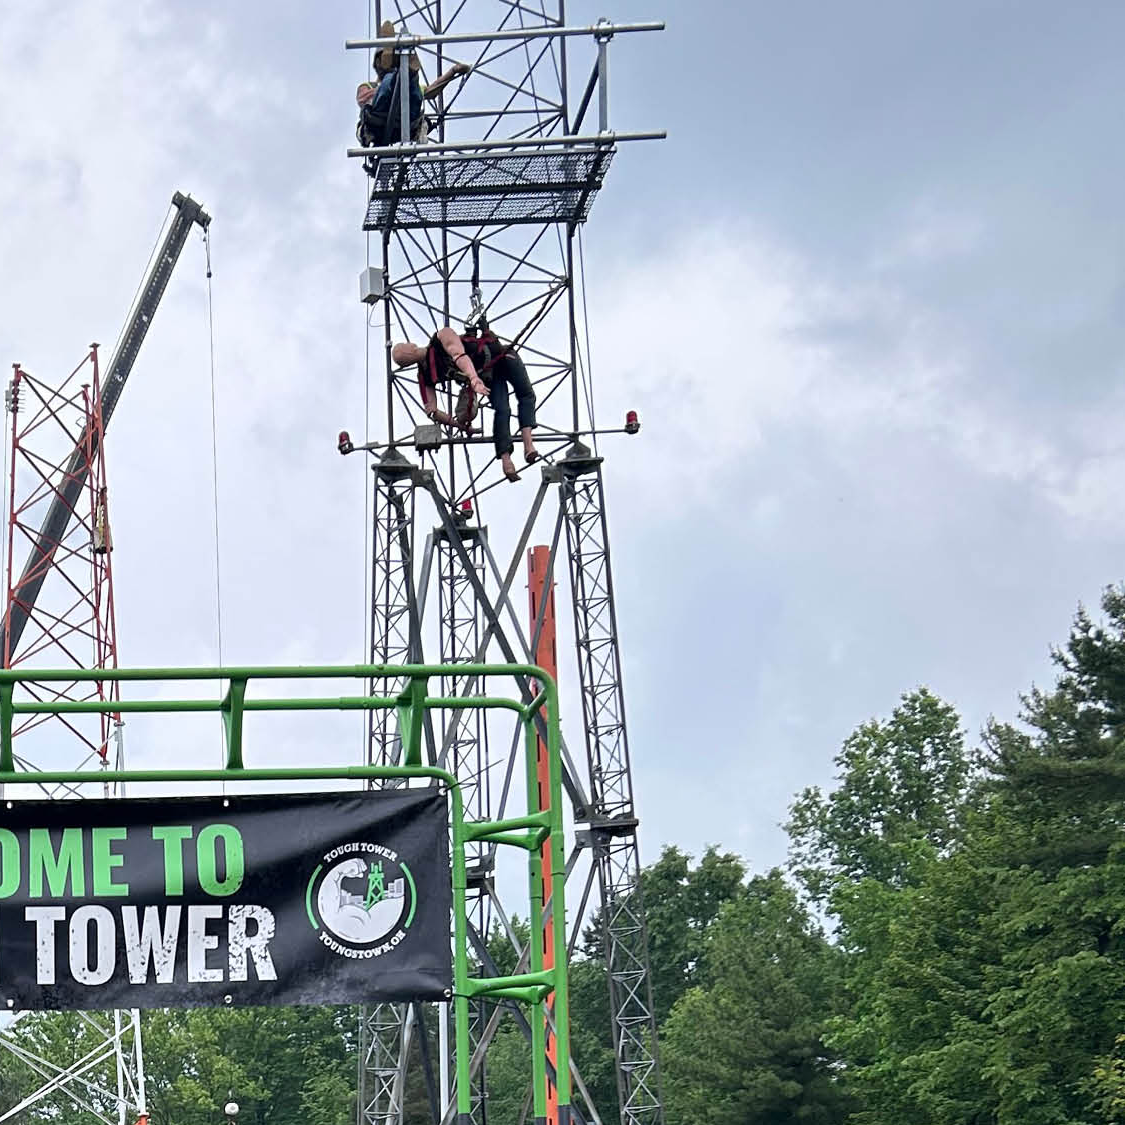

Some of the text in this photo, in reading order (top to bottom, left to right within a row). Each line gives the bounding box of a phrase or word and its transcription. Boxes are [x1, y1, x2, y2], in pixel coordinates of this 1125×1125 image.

[152, 824, 245, 896] TO
[324, 843, 398, 863] TOUGH TOWER
[25, 904, 278, 986] TOWER
